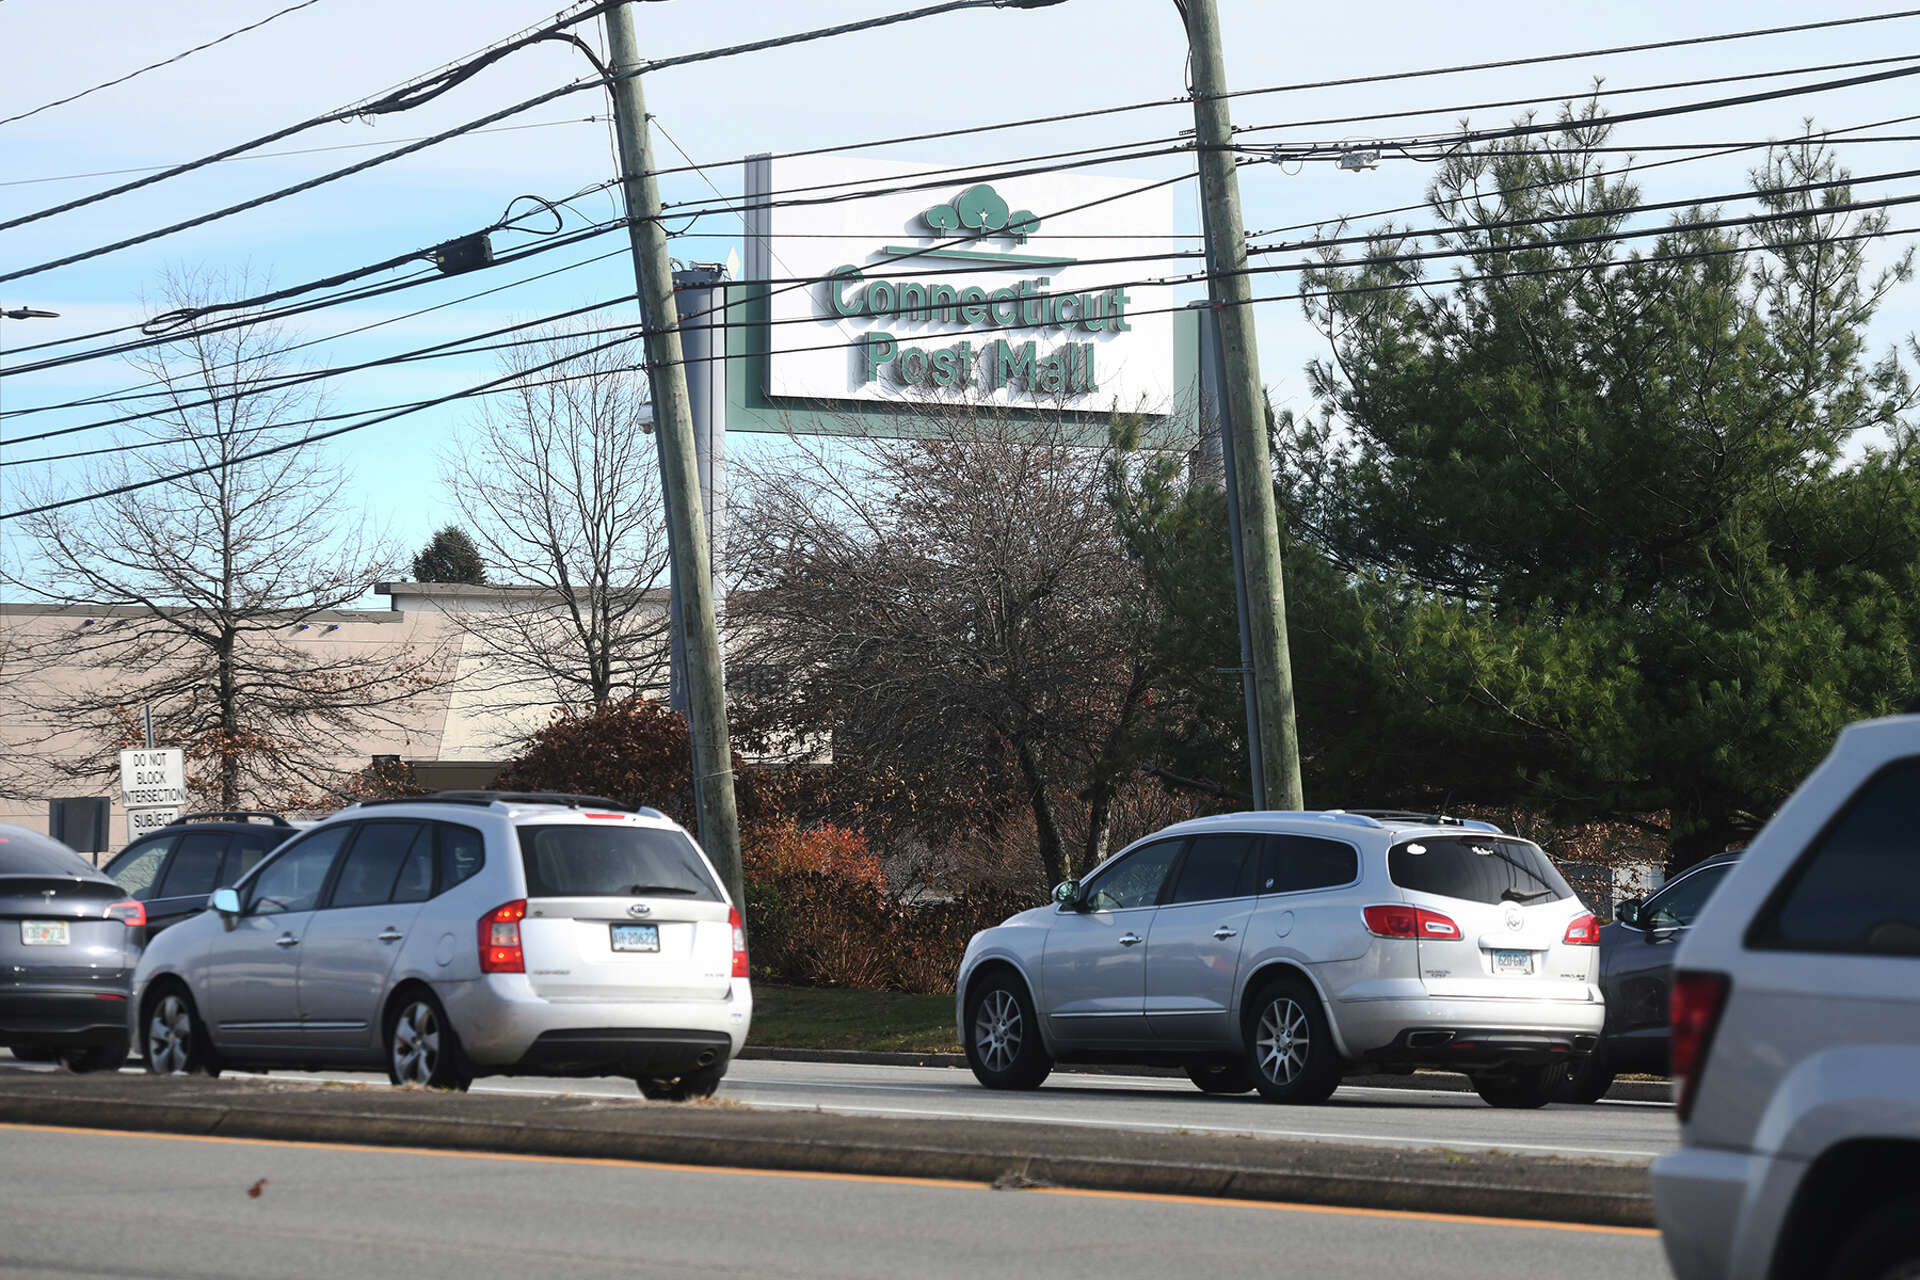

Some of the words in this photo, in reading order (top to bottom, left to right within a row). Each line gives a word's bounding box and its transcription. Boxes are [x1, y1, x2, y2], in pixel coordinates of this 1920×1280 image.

[830, 264, 1131, 332] Connecticut
[865, 331, 977, 387] Post
[993, 338, 1099, 394] Mall
[133, 753, 145, 767] DO
[149, 752, 167, 767] NOT
[137, 771, 166, 785] BLOCK
[122, 788, 187, 803] INTERSECTION
[134, 812, 174, 828] SUBJECT
